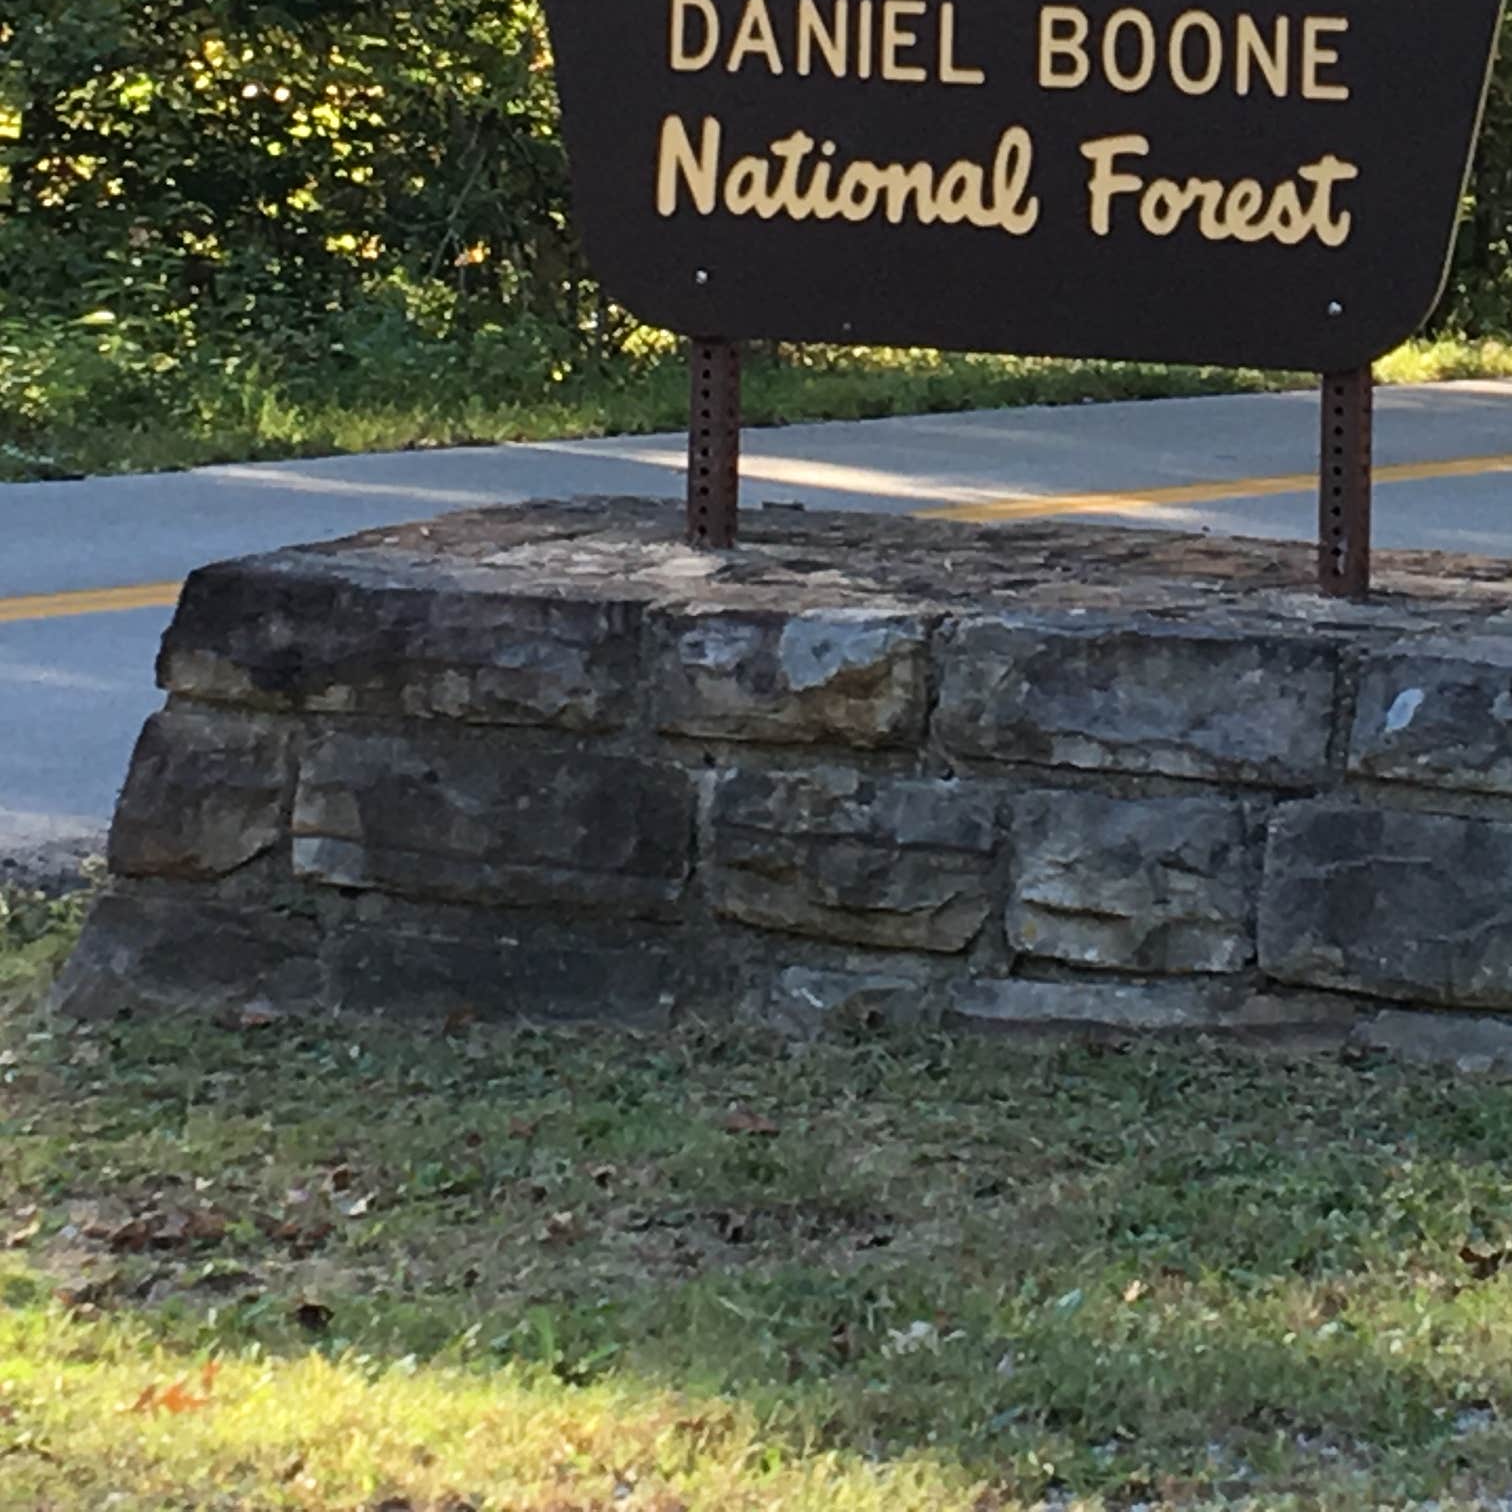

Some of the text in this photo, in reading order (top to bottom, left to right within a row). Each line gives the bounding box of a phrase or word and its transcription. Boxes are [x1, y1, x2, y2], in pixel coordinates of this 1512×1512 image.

[1039, 6, 1349, 100] BOONE
[656, 114, 1358, 247] National Forest
